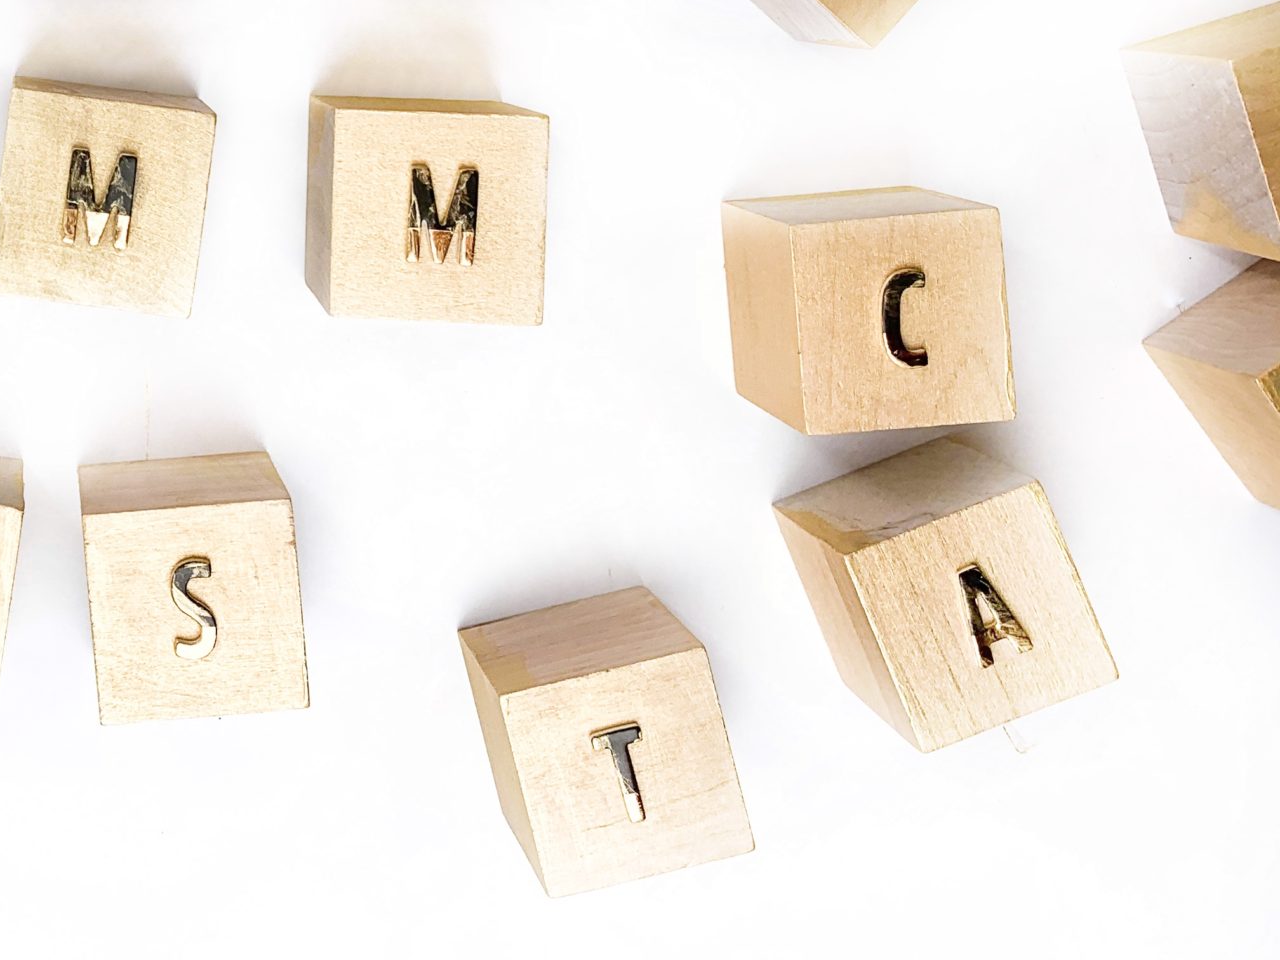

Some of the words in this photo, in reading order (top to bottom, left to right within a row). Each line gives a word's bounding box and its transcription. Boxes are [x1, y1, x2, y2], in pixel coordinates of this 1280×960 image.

[62, 146, 138, 250] M
[407, 162, 480, 265] M
[882, 265, 928, 368] C
[170, 556, 218, 660] S
[958, 562, 1032, 669] A
[590, 722, 646, 823] T
